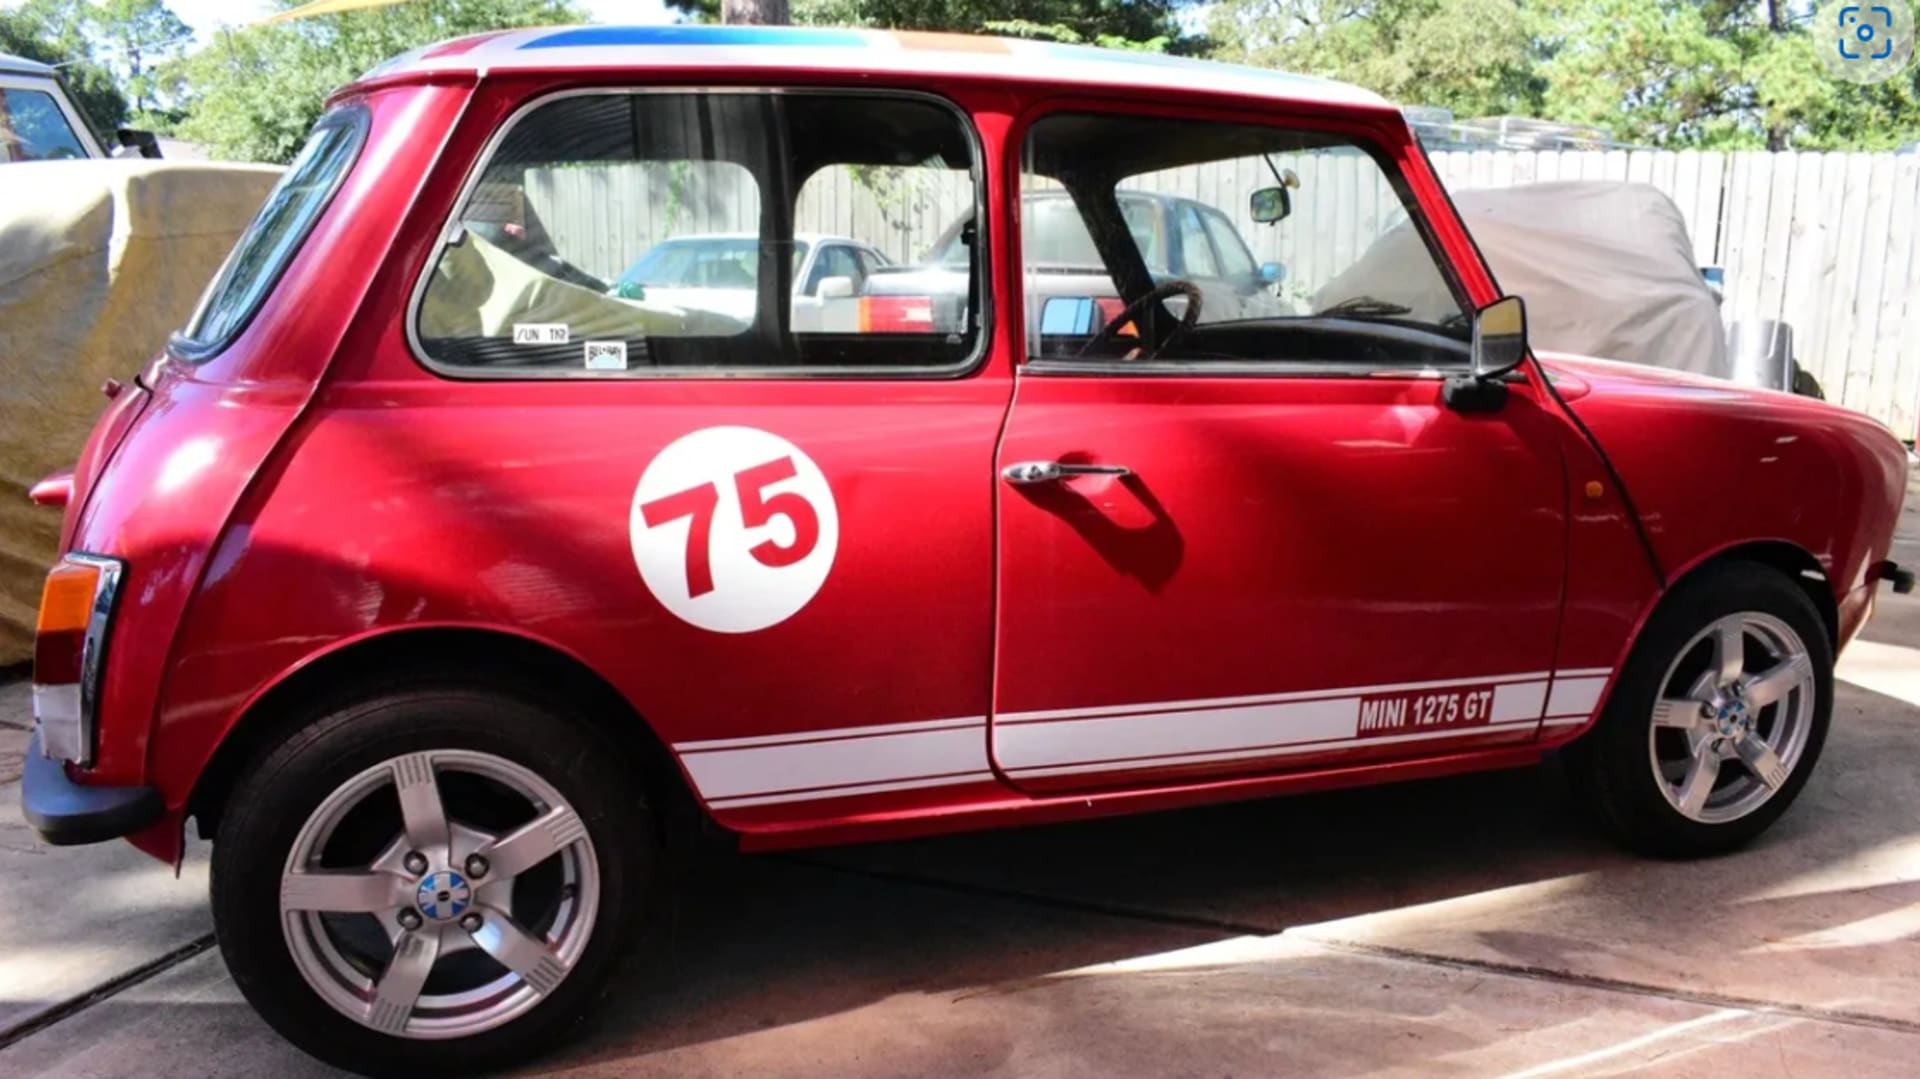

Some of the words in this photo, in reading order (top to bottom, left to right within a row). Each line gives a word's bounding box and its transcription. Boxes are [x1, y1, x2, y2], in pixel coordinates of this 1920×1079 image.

[640, 455, 820, 599] 75
[1360, 698, 1408, 731] MINI
[1413, 693, 1460, 726] 1275
[1463, 690, 1492, 720] GT
